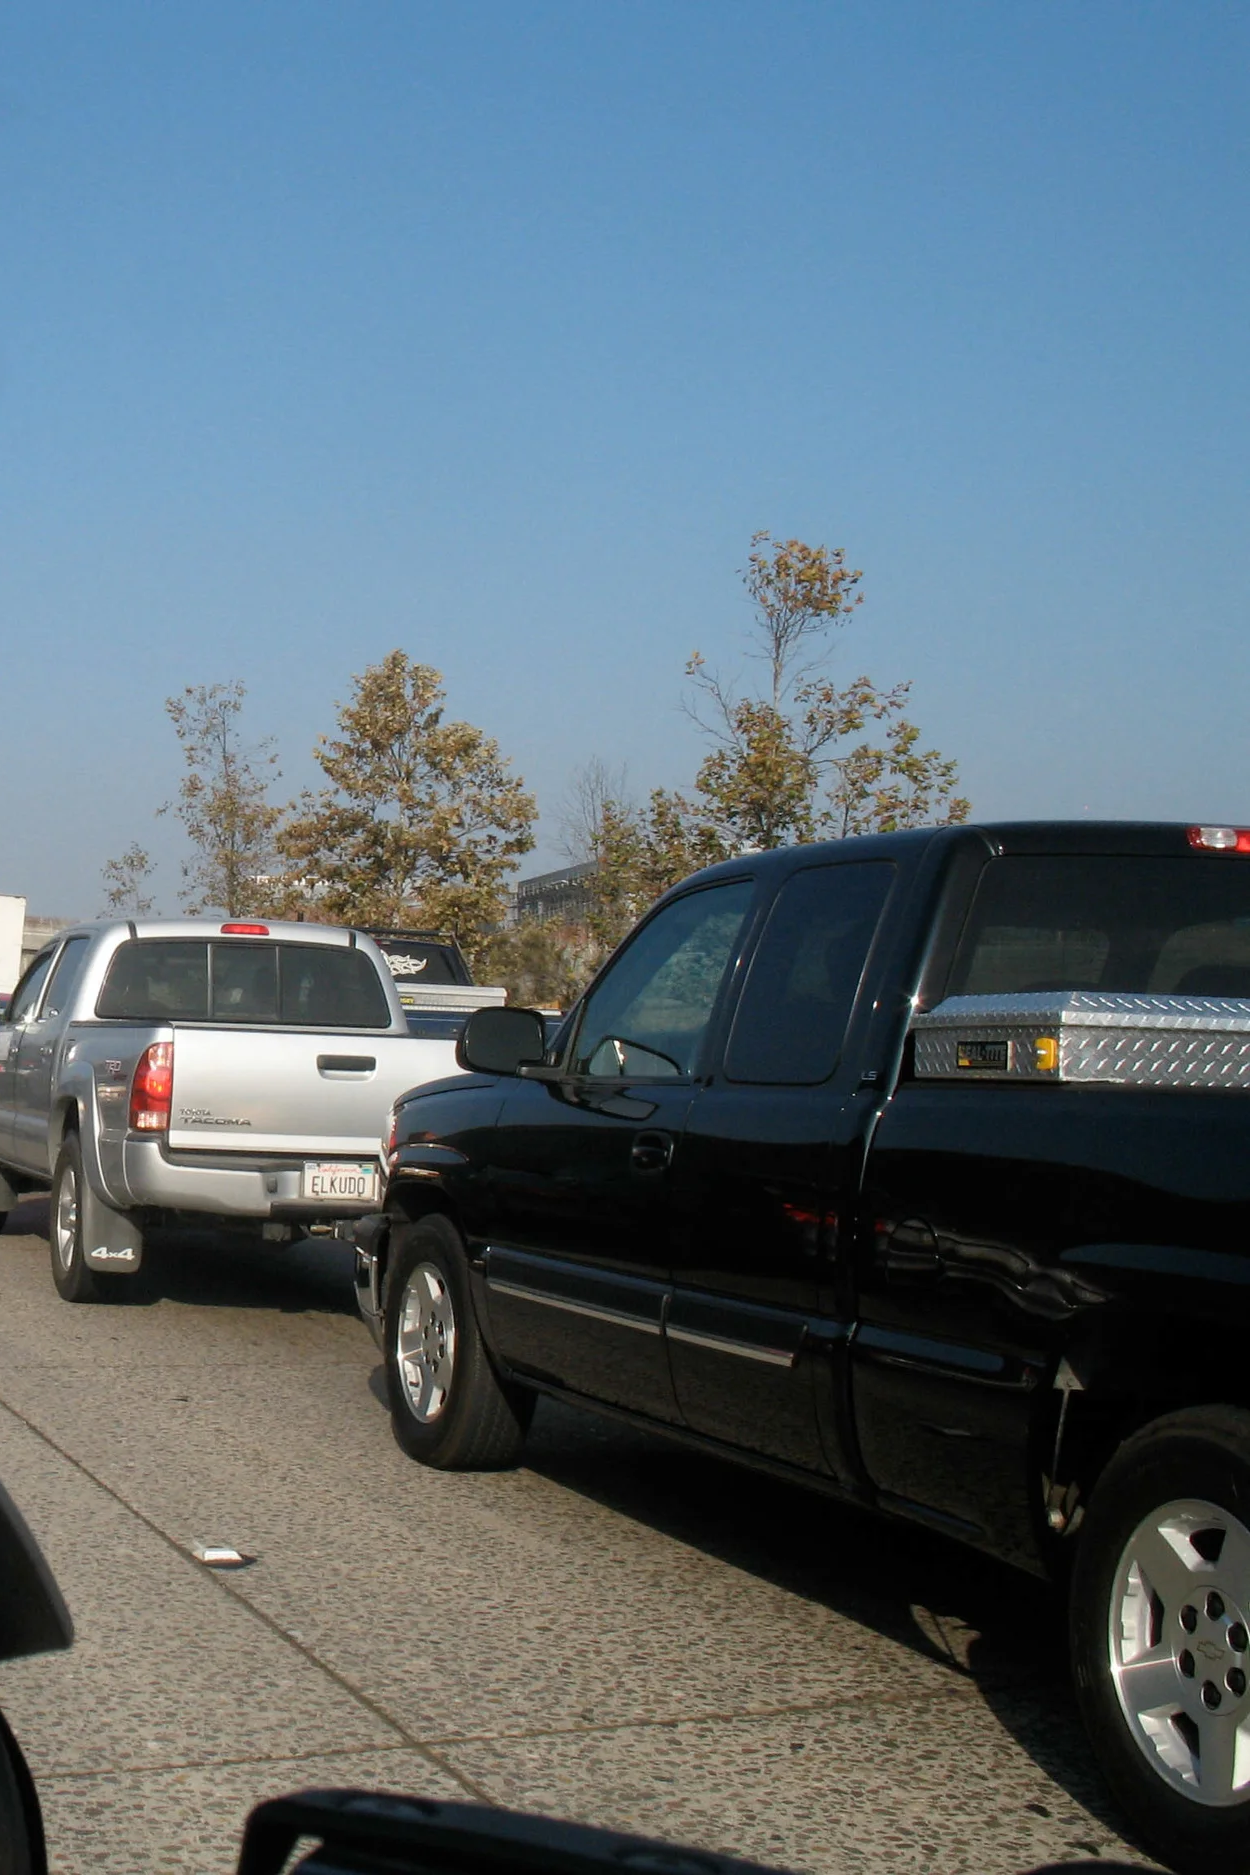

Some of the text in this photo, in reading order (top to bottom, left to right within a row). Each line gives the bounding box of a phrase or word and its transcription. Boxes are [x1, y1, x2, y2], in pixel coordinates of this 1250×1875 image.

[861, 1071, 879, 1081] LS
[179, 1108, 211, 1116] TOYOTA
[179, 1116, 252, 1127] TACOMA
[311, 1175, 367, 1195] ELKUDO
[90, 1246, 136, 1261] 4x4
